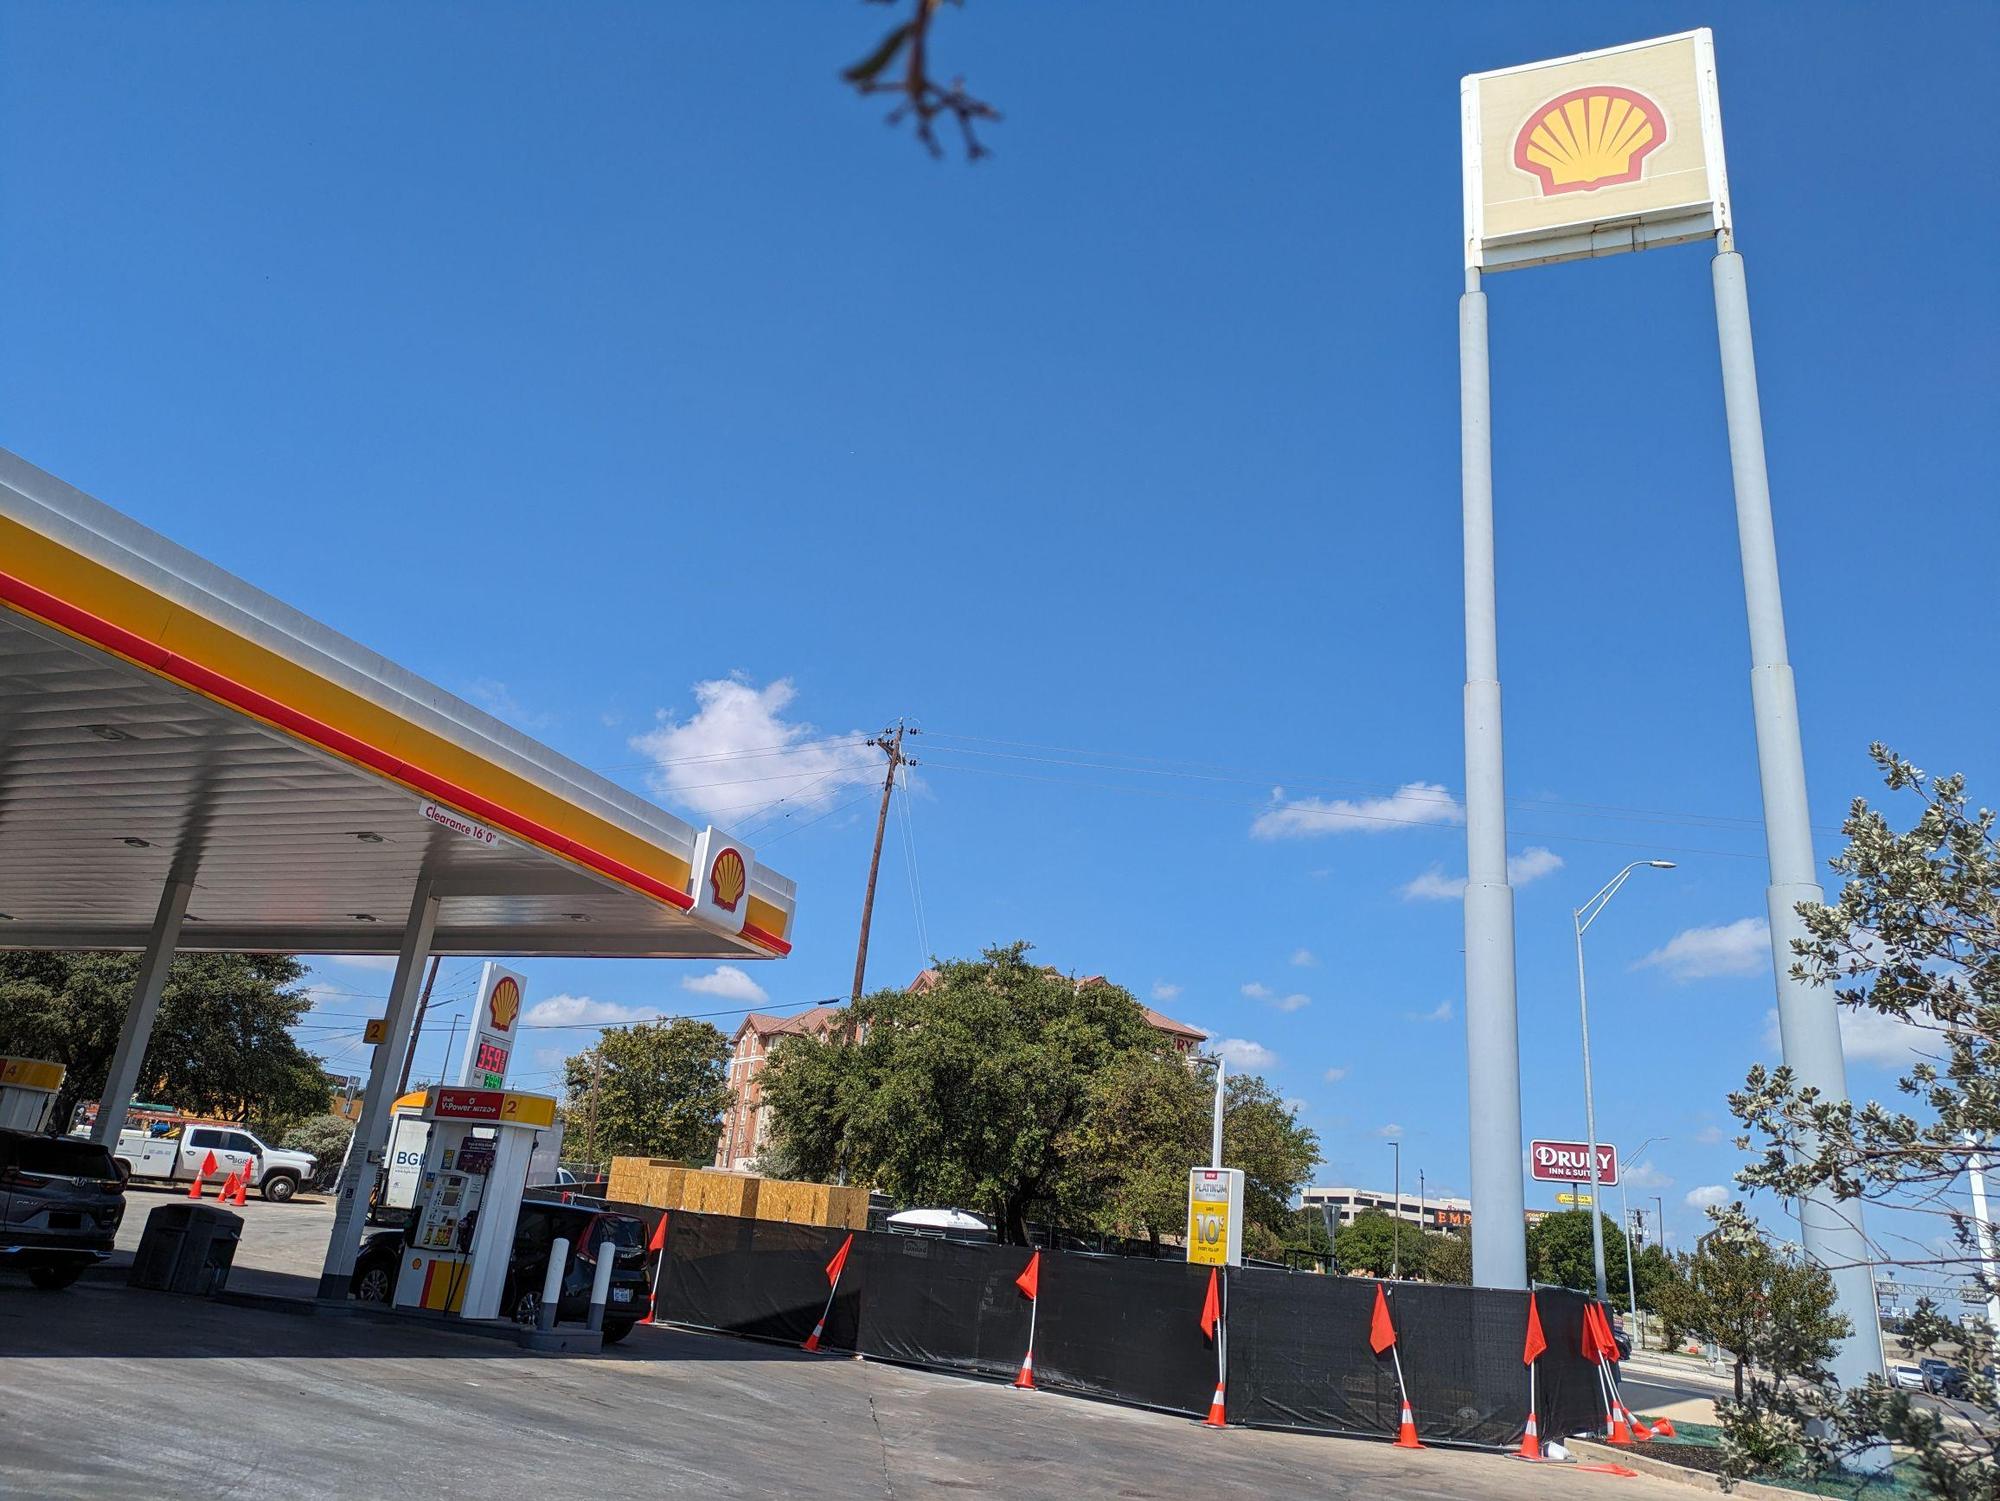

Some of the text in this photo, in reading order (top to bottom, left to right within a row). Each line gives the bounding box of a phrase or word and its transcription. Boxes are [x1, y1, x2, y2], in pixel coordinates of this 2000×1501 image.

[425, 806, 471, 834] Clearance
[370, 1023, 380, 1038] 2
[7, 1065, 17, 1077] 4
[506, 1100, 518, 1114] 2
[1549, 1167, 1603, 1178] INN & SUITS
[1195, 1183, 1228, 1193] PLATINUM
